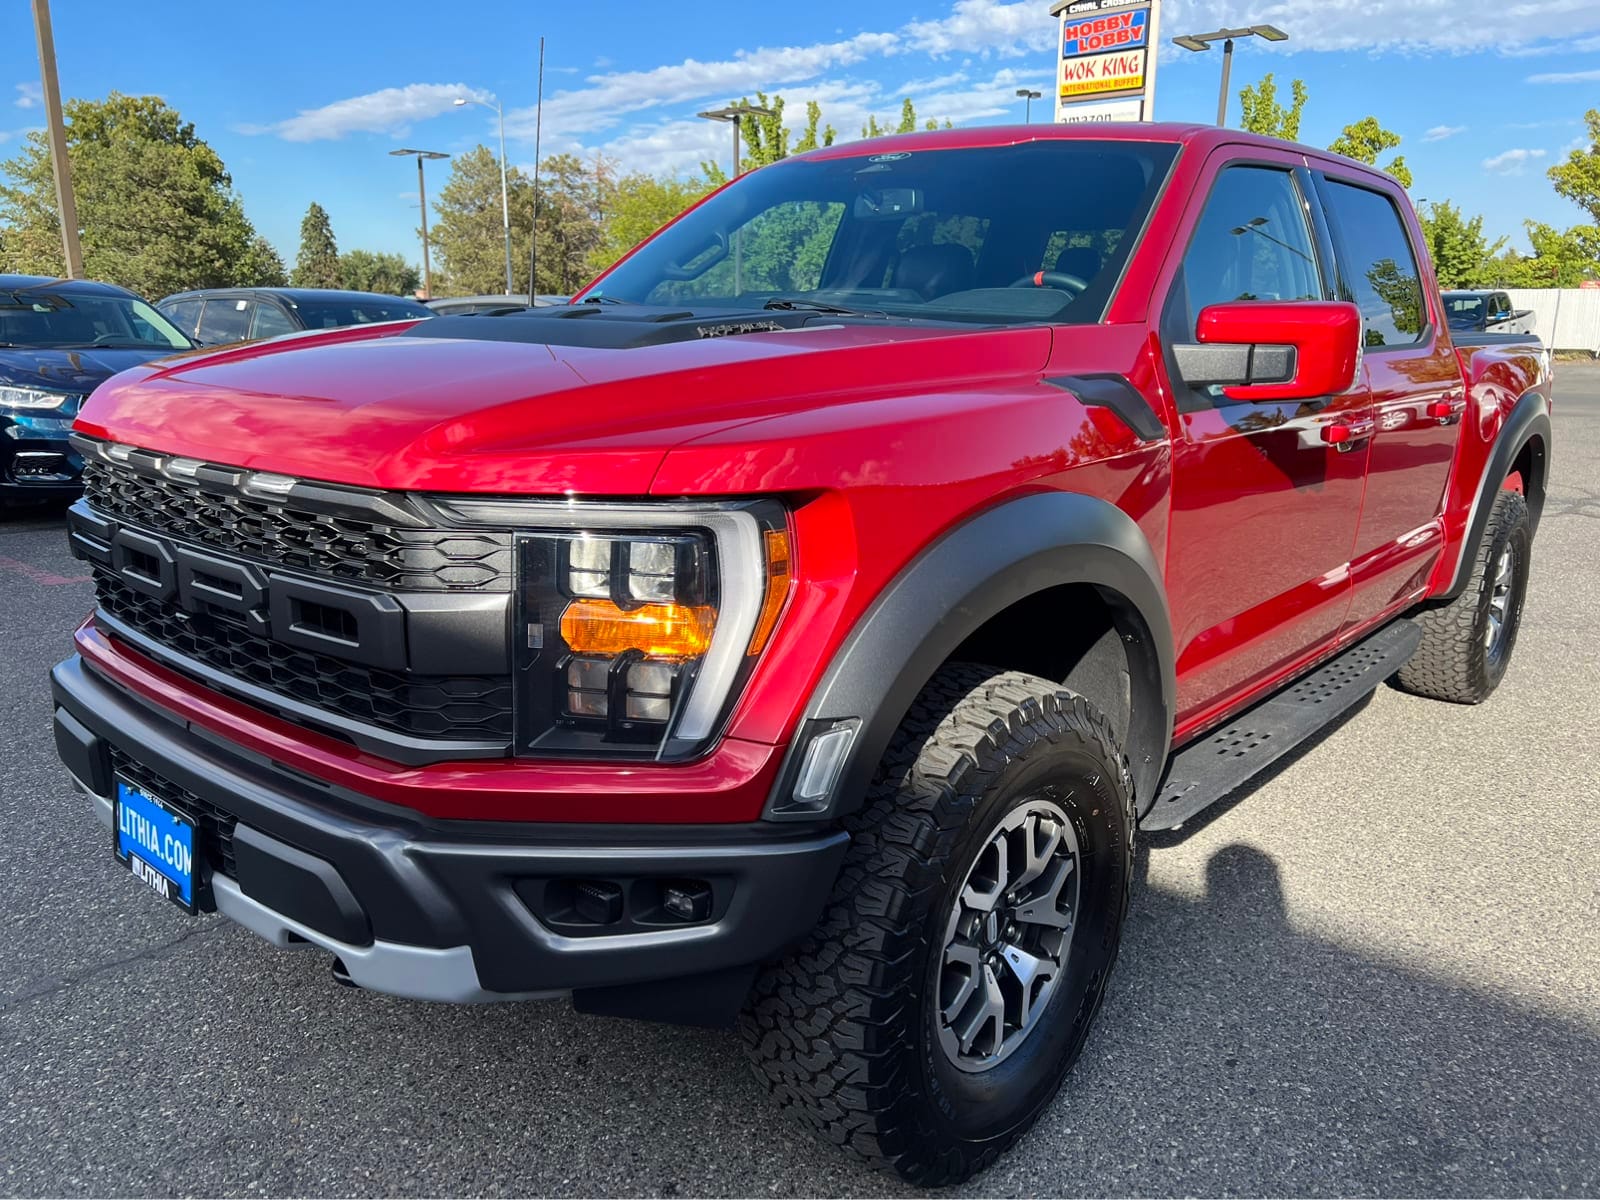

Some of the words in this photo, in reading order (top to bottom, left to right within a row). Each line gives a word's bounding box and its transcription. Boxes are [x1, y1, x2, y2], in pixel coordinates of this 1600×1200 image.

[1069, 1, 1099, 14] CANAL
[1065, 12, 1134, 41] HOBBY
[1078, 25, 1143, 53] LOBBY
[1064, 60, 1097, 81] WOK
[1102, 54, 1138, 77] KING
[1063, 81, 1111, 92] INTERNATIONAL
[1114, 77, 1139, 87] BUFFET
[140, 861, 169, 899] LITHIA
